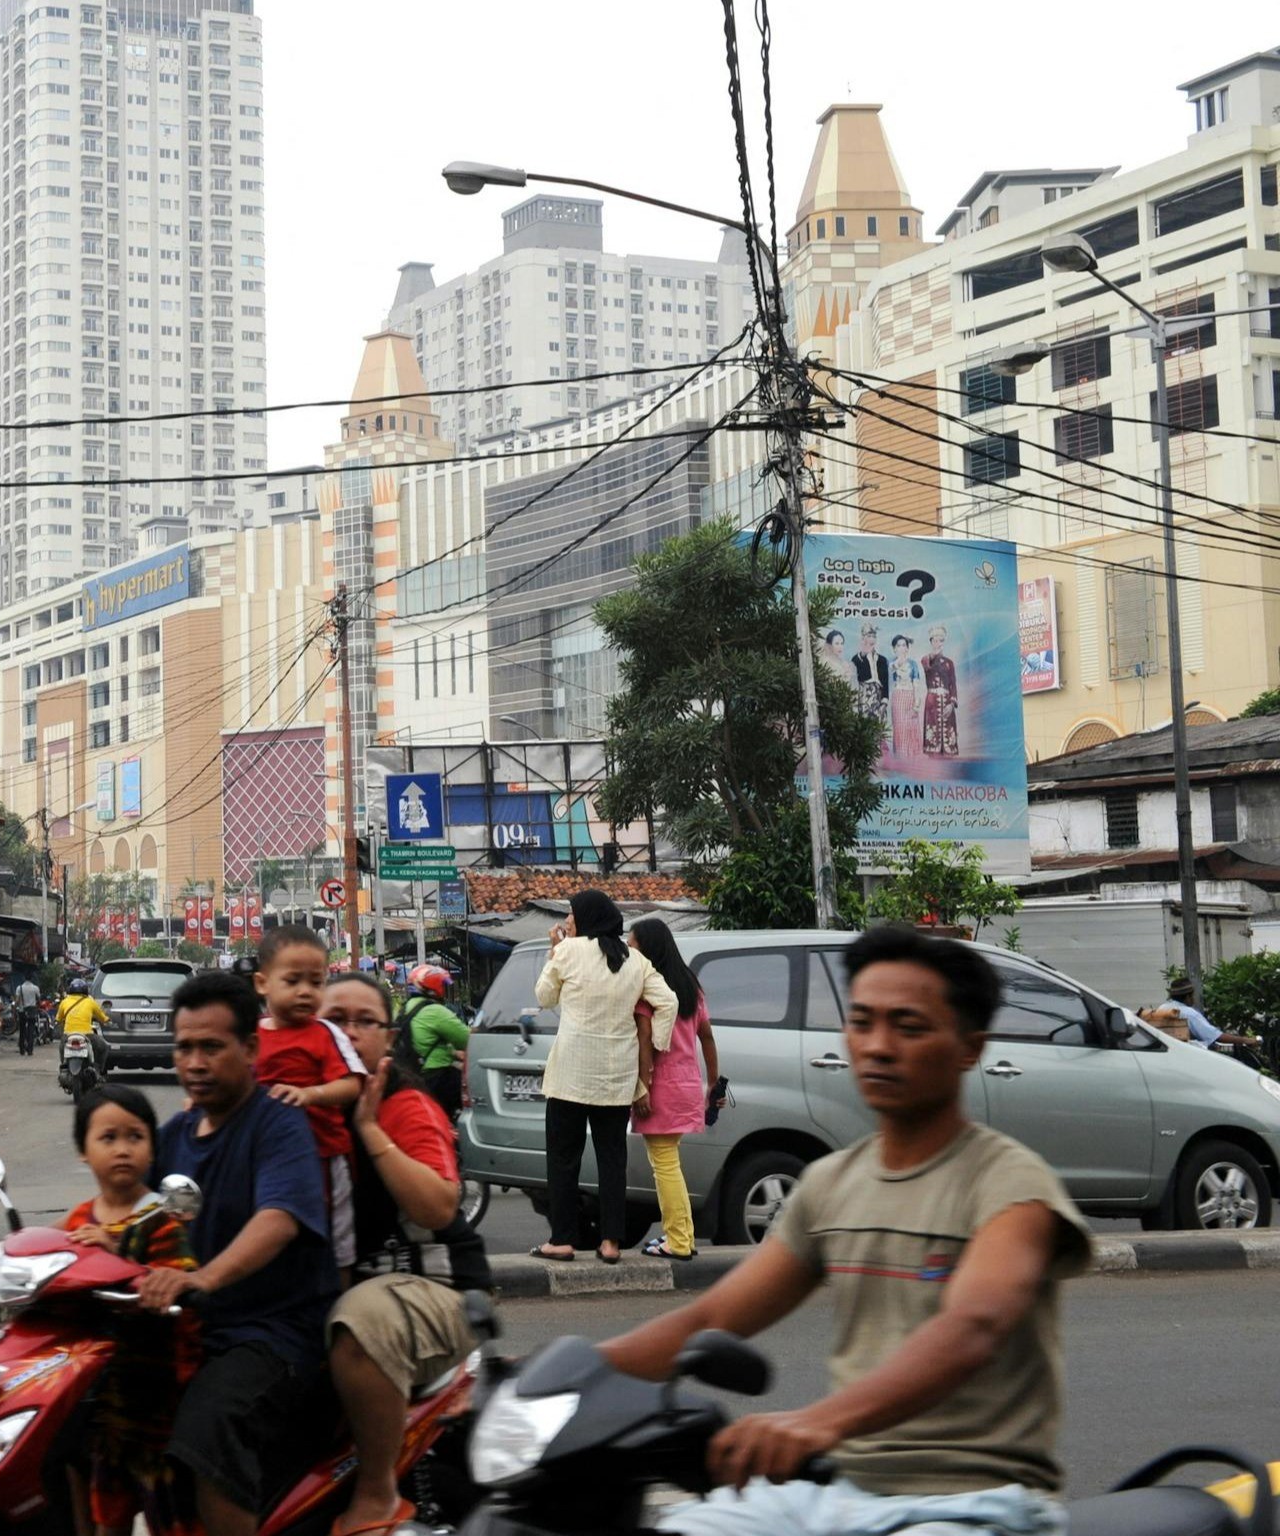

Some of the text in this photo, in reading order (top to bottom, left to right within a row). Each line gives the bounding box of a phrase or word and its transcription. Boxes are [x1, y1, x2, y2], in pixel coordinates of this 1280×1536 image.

[824, 557, 895, 575] Loe ingin
[100, 555, 185, 617] hypermart
[817, 573, 866, 586] Sehat,
[837, 588, 885, 601] erdas,
[896, 569, 936, 619] ?
[833, 608, 909, 618] rprestasi
[880, 784, 1008, 802] HKAN NARKOBA
